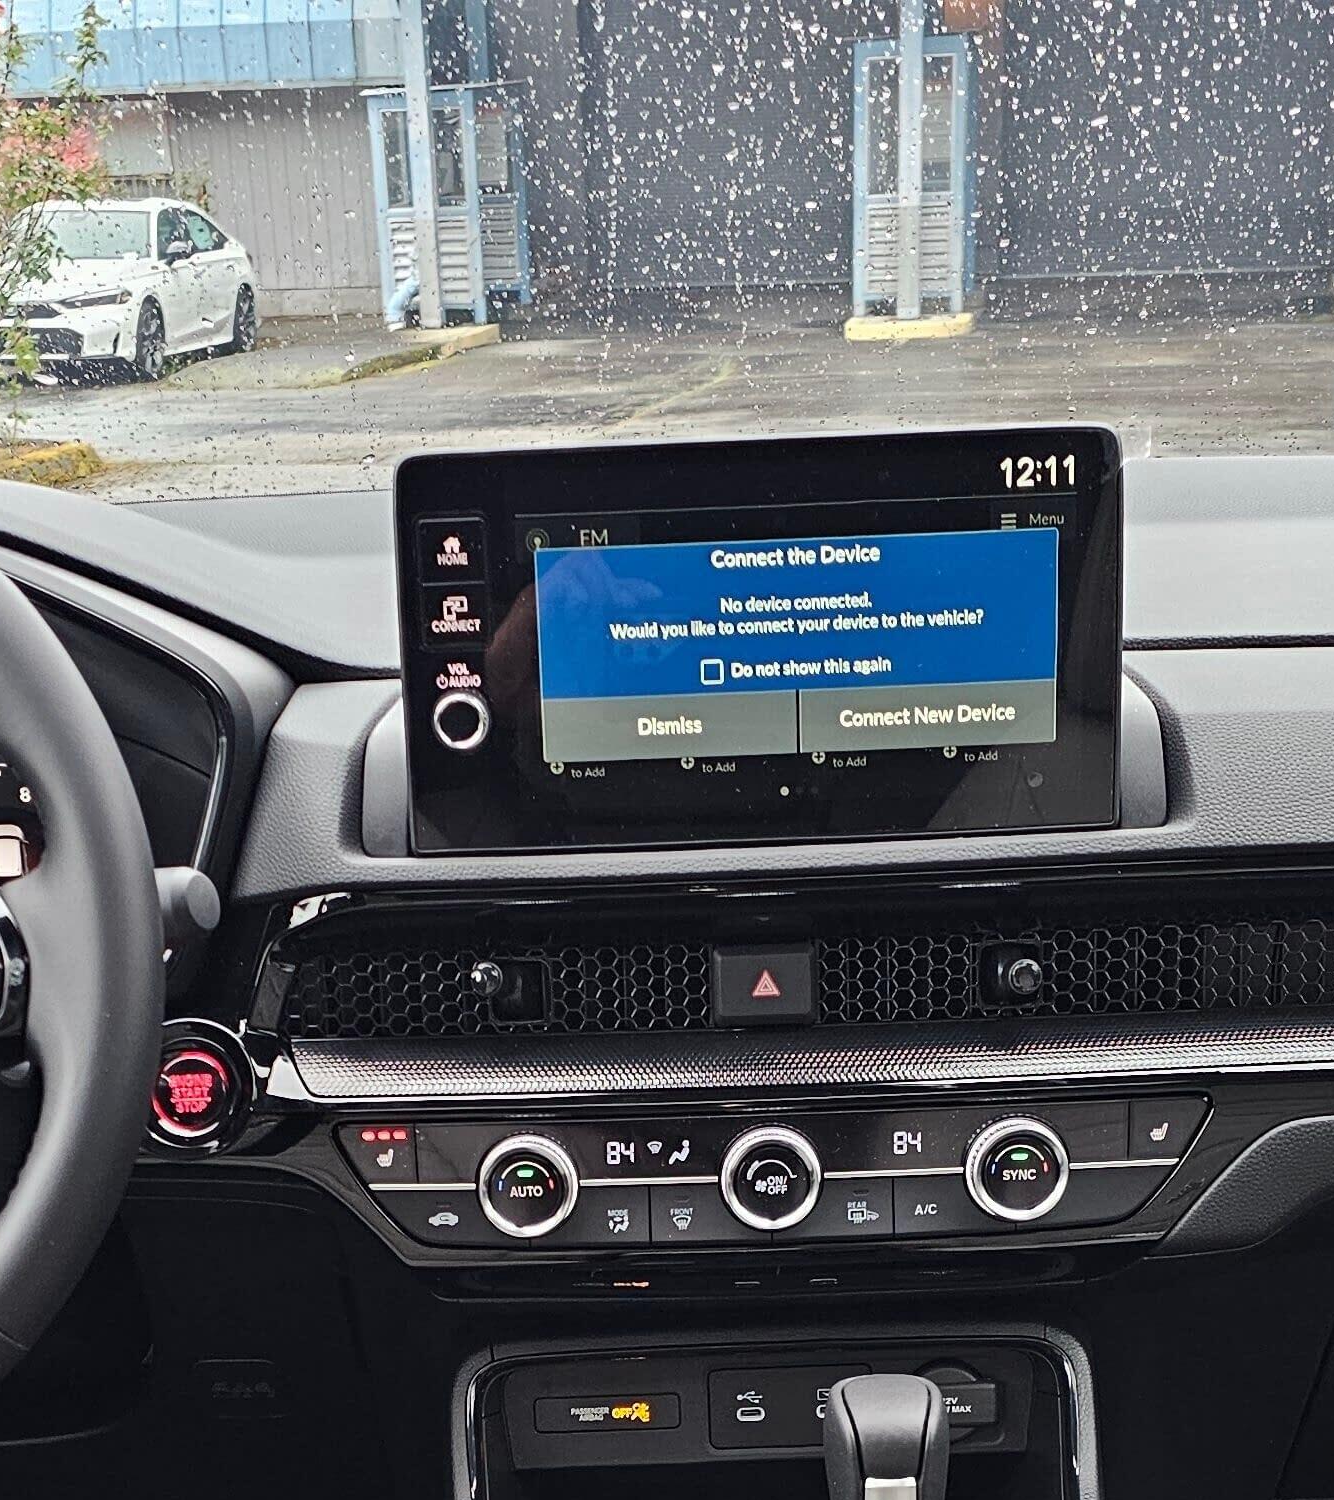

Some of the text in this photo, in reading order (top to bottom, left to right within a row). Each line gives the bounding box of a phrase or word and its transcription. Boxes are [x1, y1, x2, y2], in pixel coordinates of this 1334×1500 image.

[999, 454, 1076, 489] 12:11
[1028, 513, 1065, 526] Menu
[579, 529, 609, 547] FM
[437, 552, 469, 566] HOME
[710, 544, 881, 569] Connect the Device
[720, 591, 873, 614] No device connected.
[431, 618, 482, 633] CONNECT
[609, 608, 984, 642] Would you like to connect your device to the vehicle?
[447, 663, 470, 676] VOL
[730, 655, 892, 678] Do not show this again
[449, 674, 482, 688] AUDIO
[838, 702, 1016, 728] Connect New Device
[637, 715, 703, 736] Dismiss
[832, 756, 867, 768] to Add
[964, 750, 998, 763] to Add
[571, 766, 606, 779] to Add
[701, 761, 736, 774] to Add
[19, 786, 32, 803] 8
[171, 1086, 210, 1098] START
[175, 1101, 208, 1114] STOP
[893, 1130, 923, 1155] 84
[606, 1140, 635, 1165] 84
[1002, 1168, 1037, 1181] SYNC
[509, 1185, 544, 1198] AUTO
[767, 1184, 788, 1195] OFF
[670, 1207, 694, 1216] FRONT
[847, 1201, 867, 1209] REAR
[914, 1203, 938, 1216] A/C
[607, 1208, 629, 1217] MODE
[570, 1406, 610, 1416] PASSENGER
[611, 1407, 633, 1419] OFF
[951, 1405, 972, 1413] MAX
